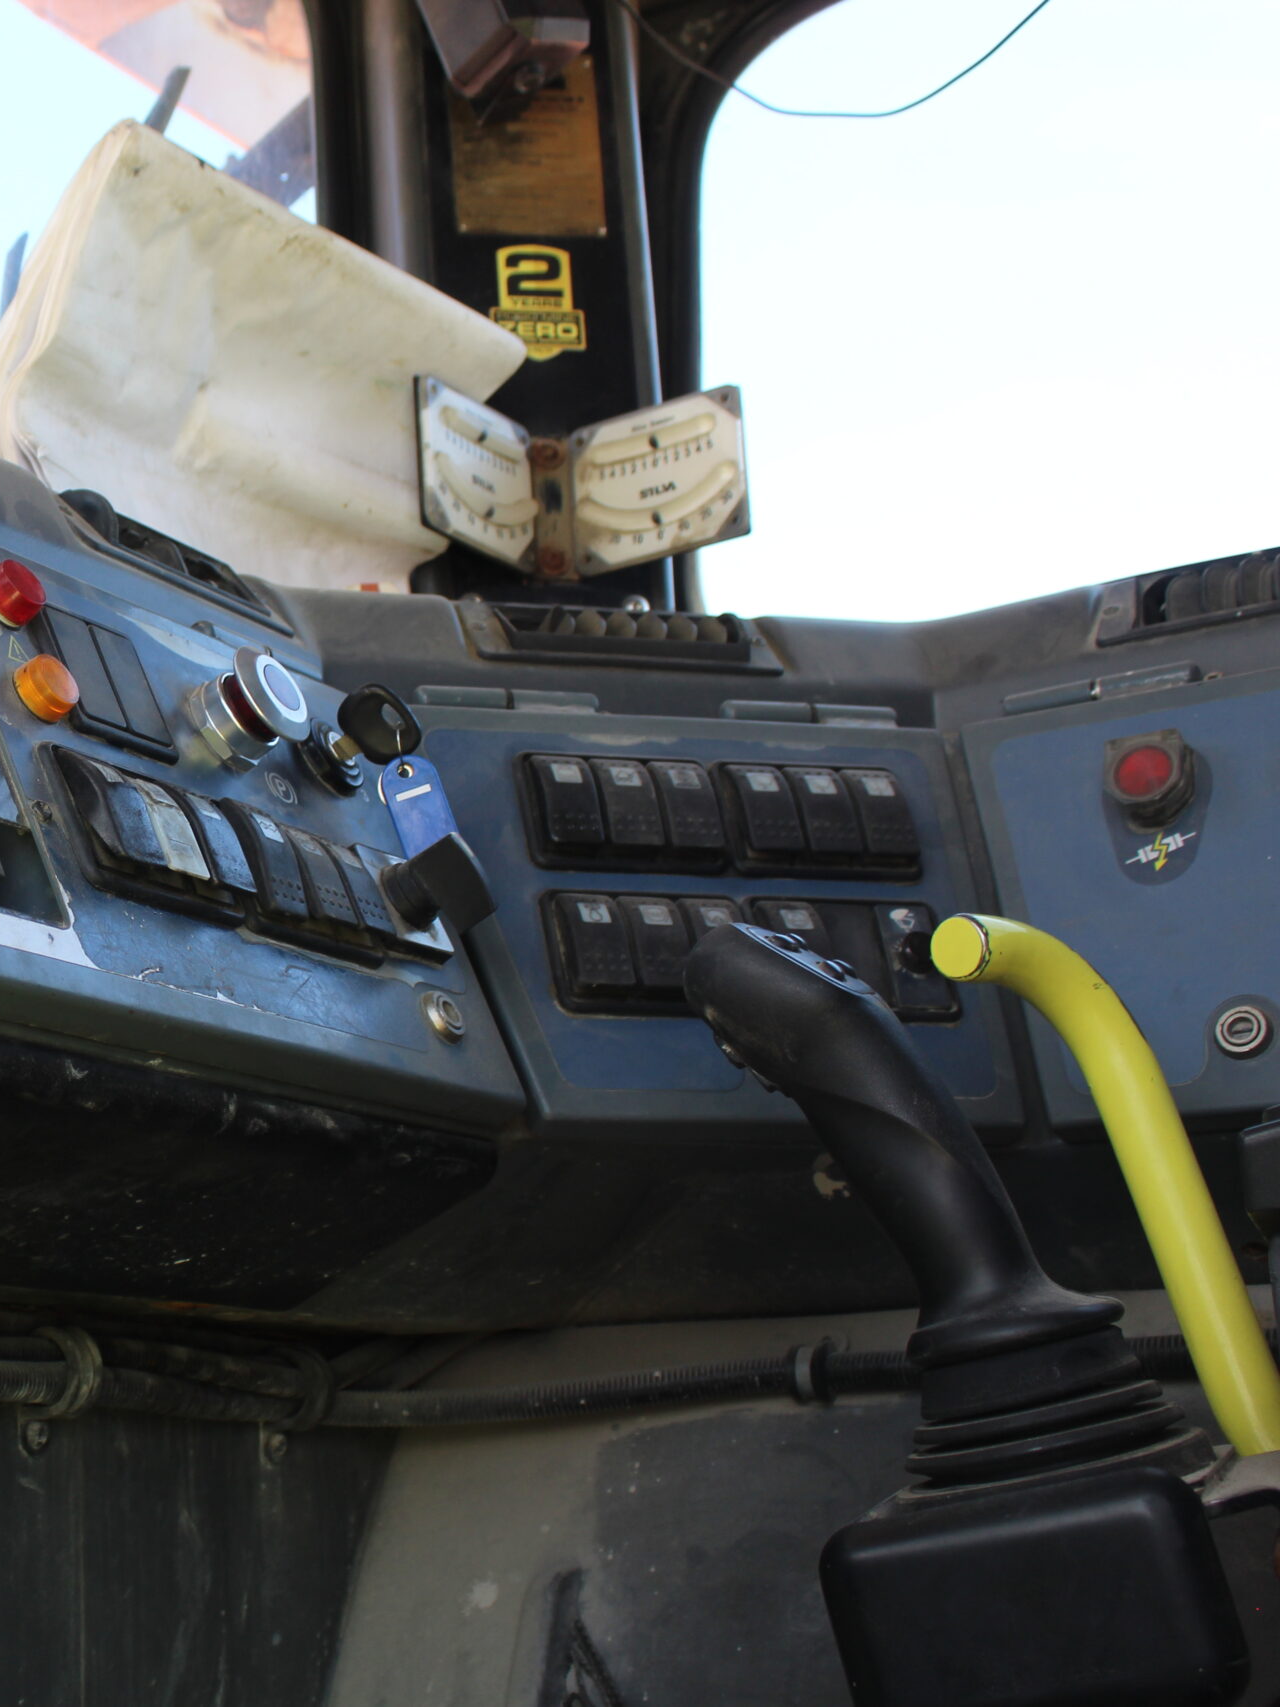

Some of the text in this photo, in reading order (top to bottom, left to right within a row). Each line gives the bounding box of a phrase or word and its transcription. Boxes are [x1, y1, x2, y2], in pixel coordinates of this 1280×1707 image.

[506, 254, 564, 297] 2
[512, 297, 563, 307] YEARS
[639, 481, 677, 500] SILVA
